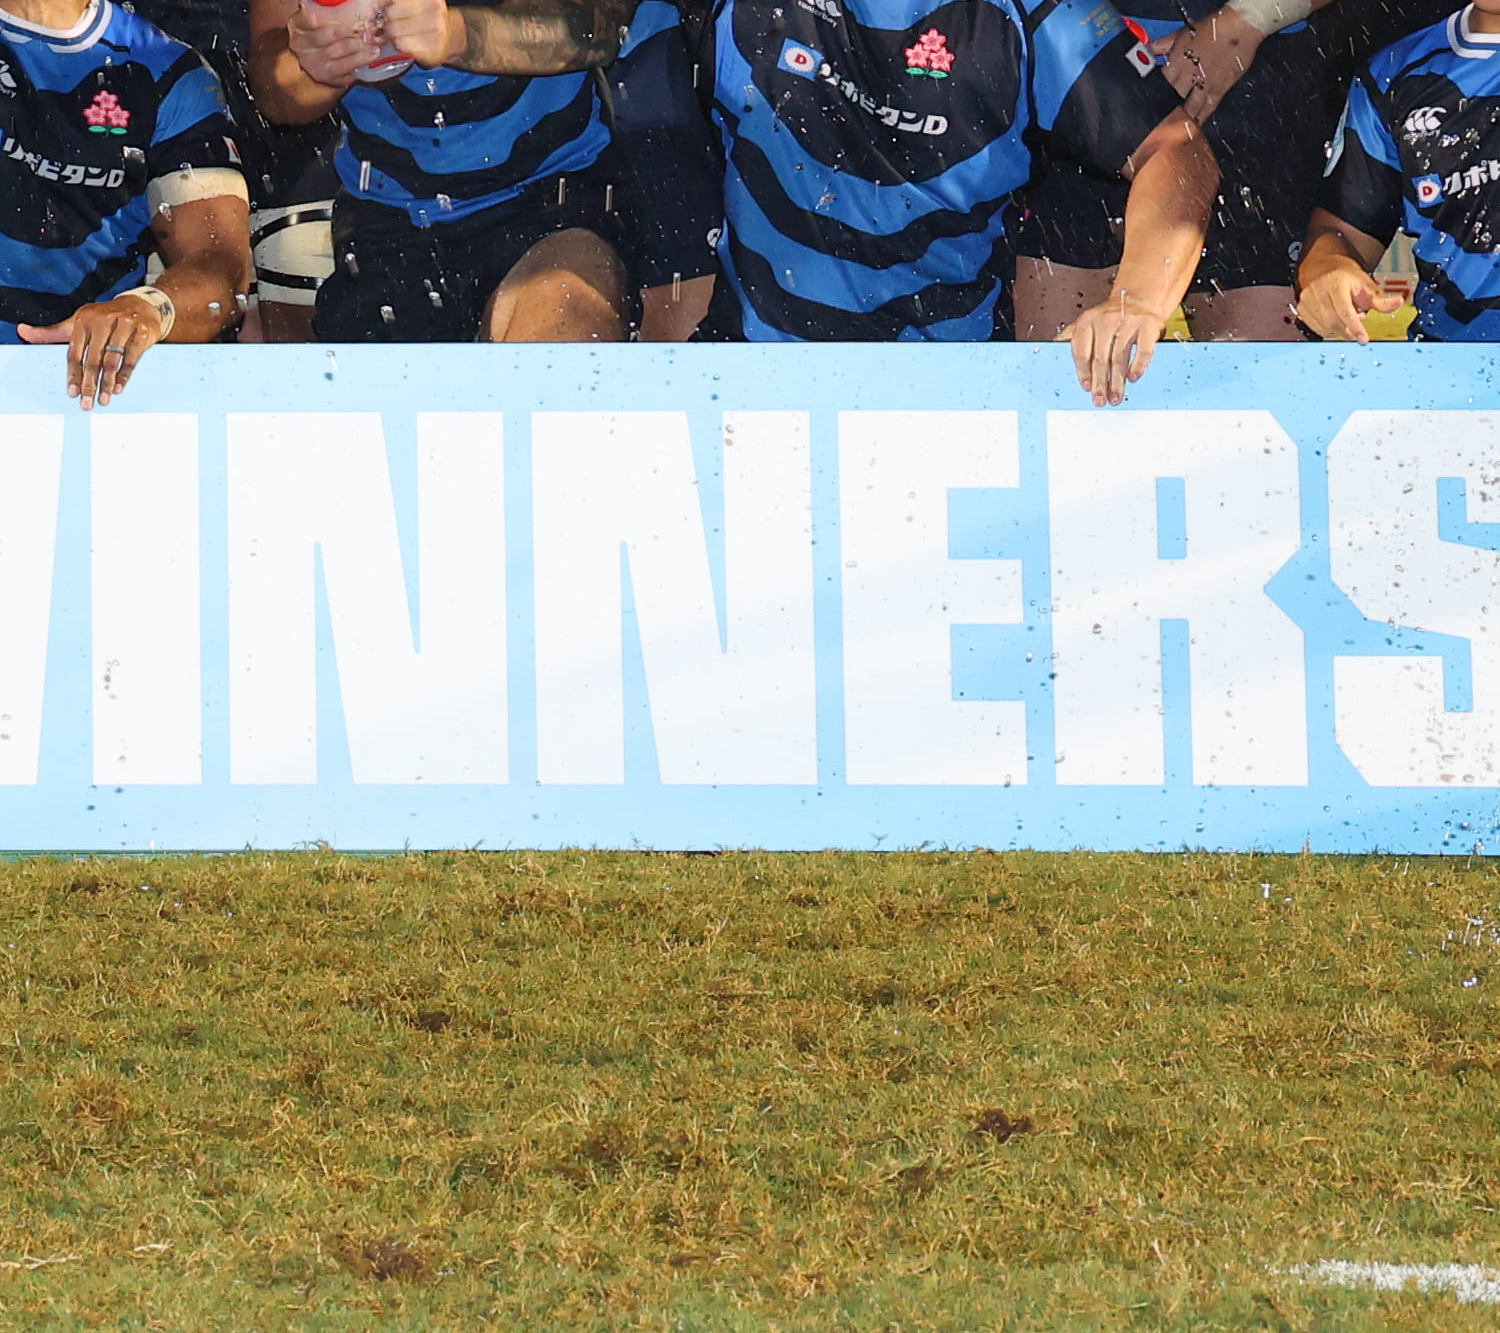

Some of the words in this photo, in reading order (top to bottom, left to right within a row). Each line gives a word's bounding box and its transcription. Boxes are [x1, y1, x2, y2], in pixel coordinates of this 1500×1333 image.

[797, 0, 838, 28] canterbury
[3, 137, 126, 188] リポビタンD
